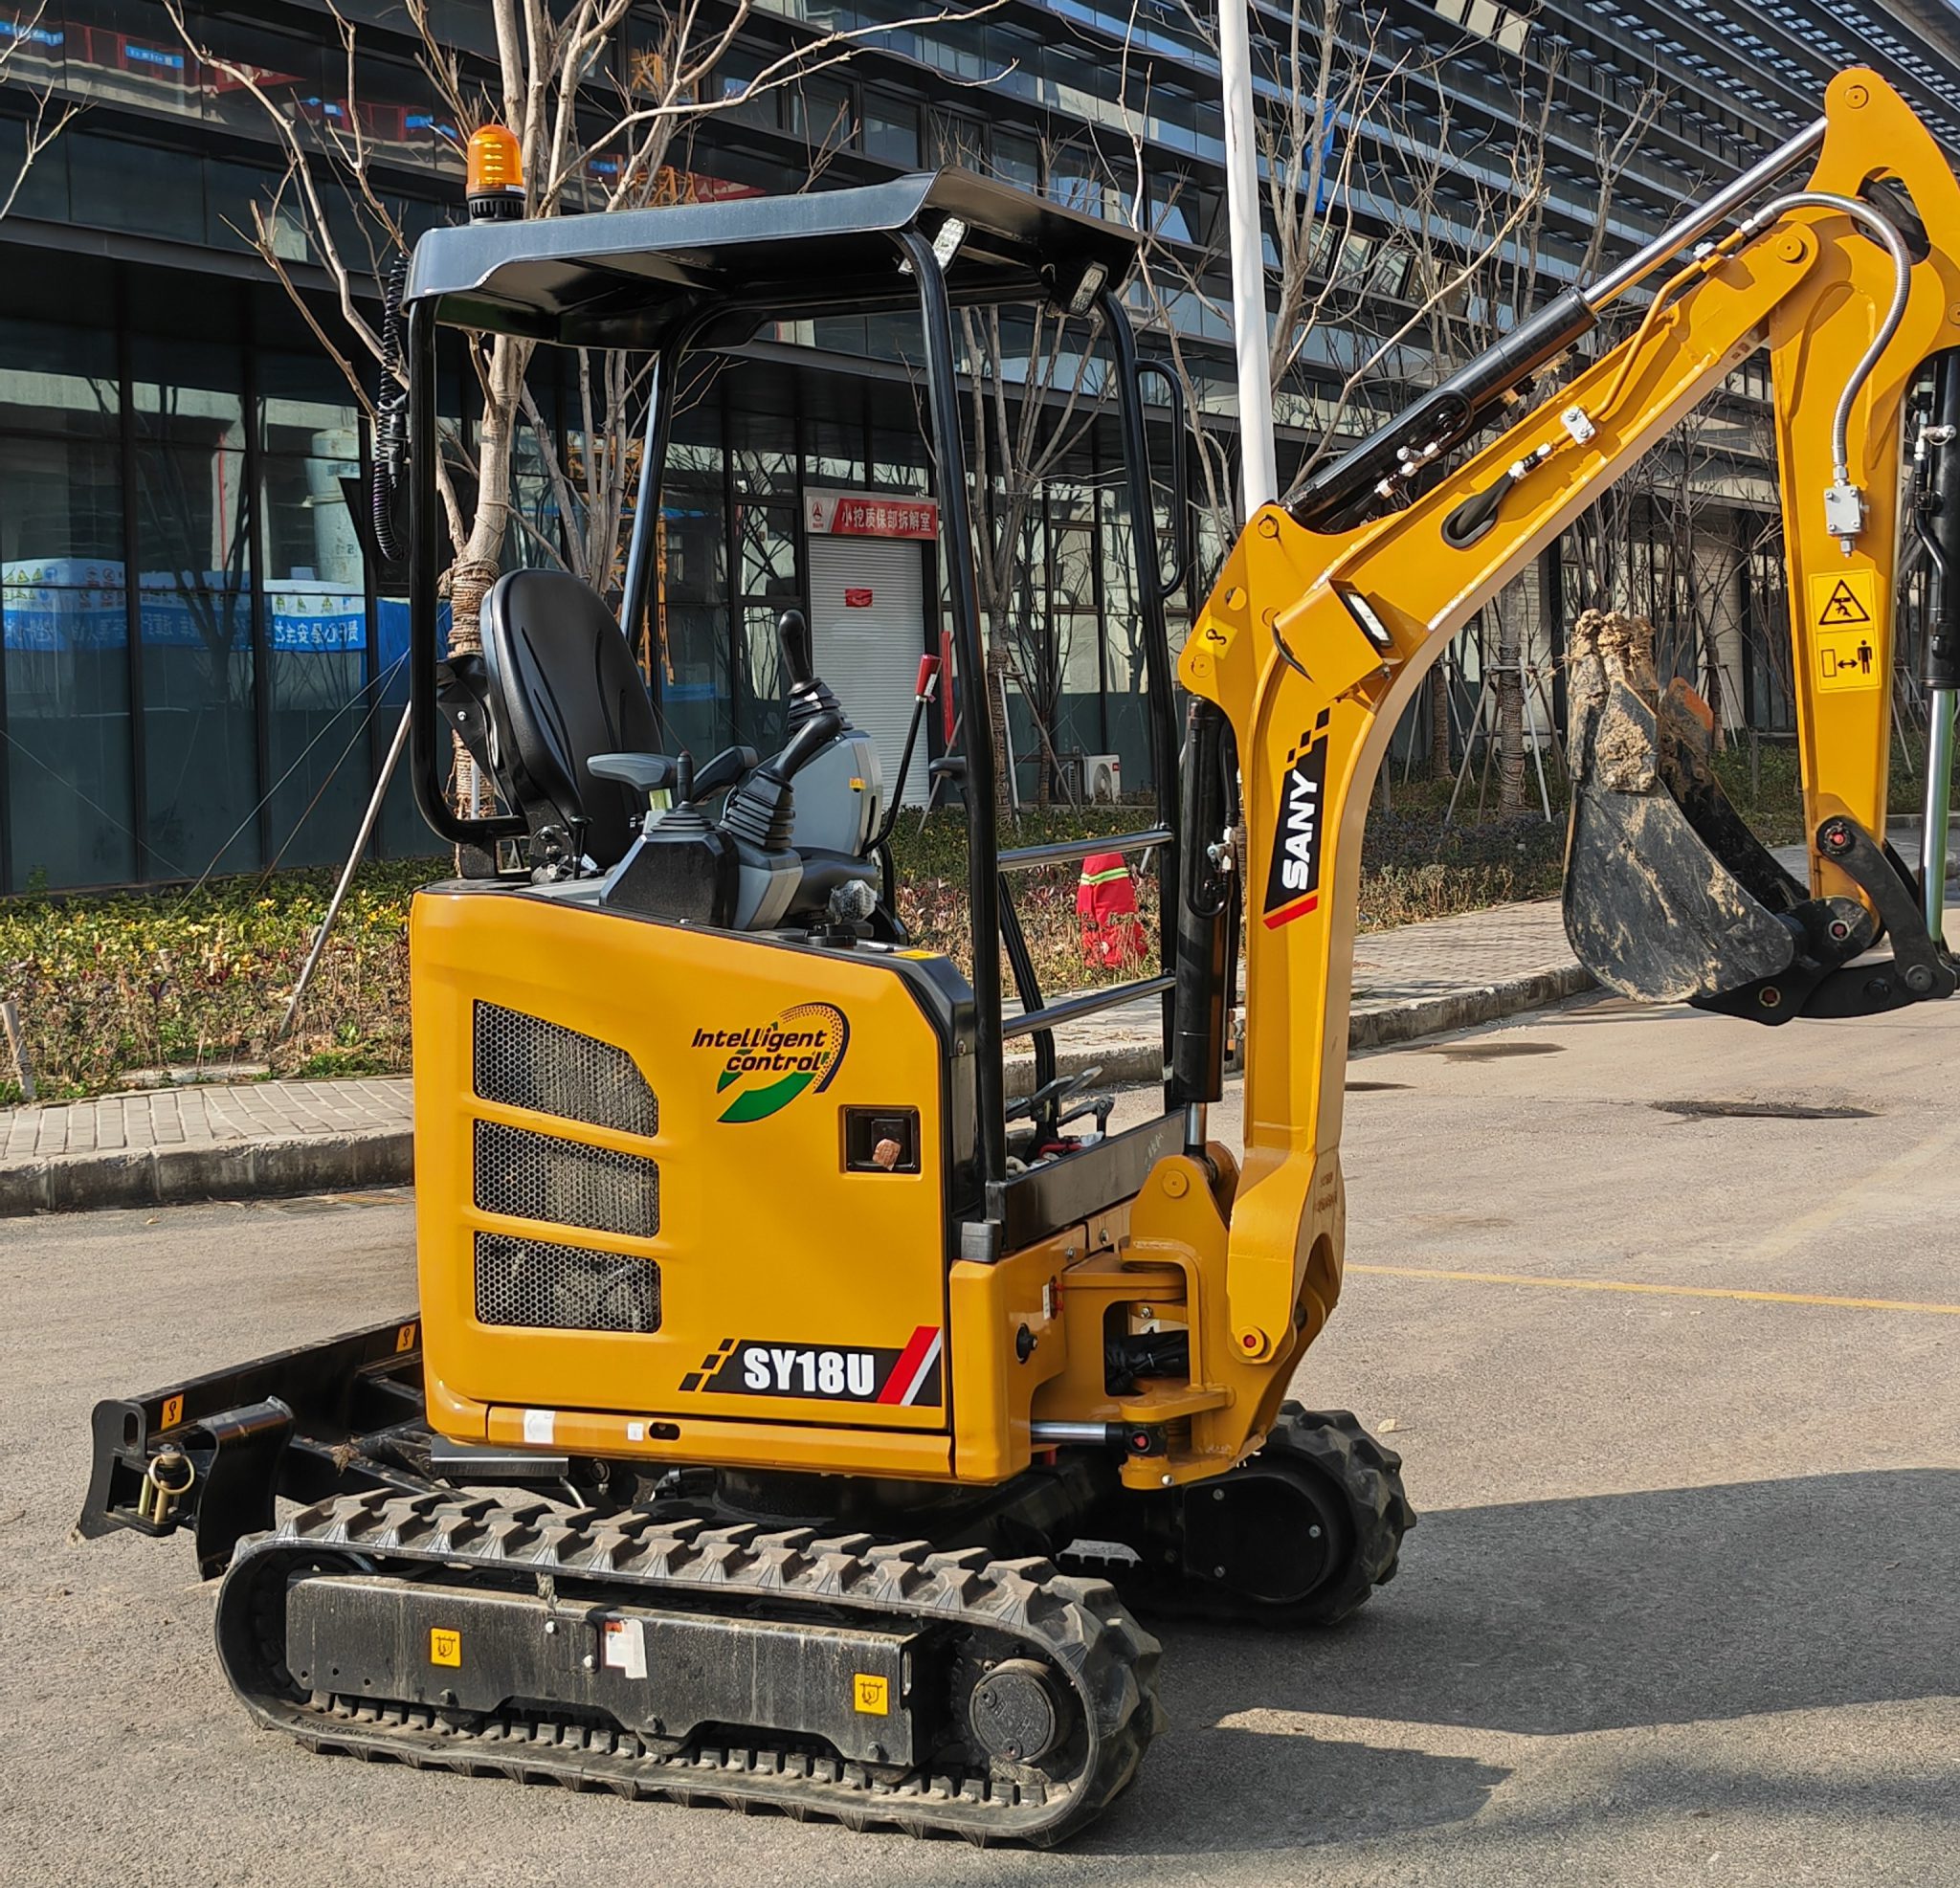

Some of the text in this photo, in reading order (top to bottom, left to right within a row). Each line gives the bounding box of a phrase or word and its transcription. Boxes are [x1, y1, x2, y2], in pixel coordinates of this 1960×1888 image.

[841, 504, 931, 531] 小挖质保部拆解室
[1282, 768, 1318, 890] SANY
[691, 1028, 828, 1053] Intelligent
[726, 1051, 821, 1071] control
[744, 1347, 875, 1396] SY18U
